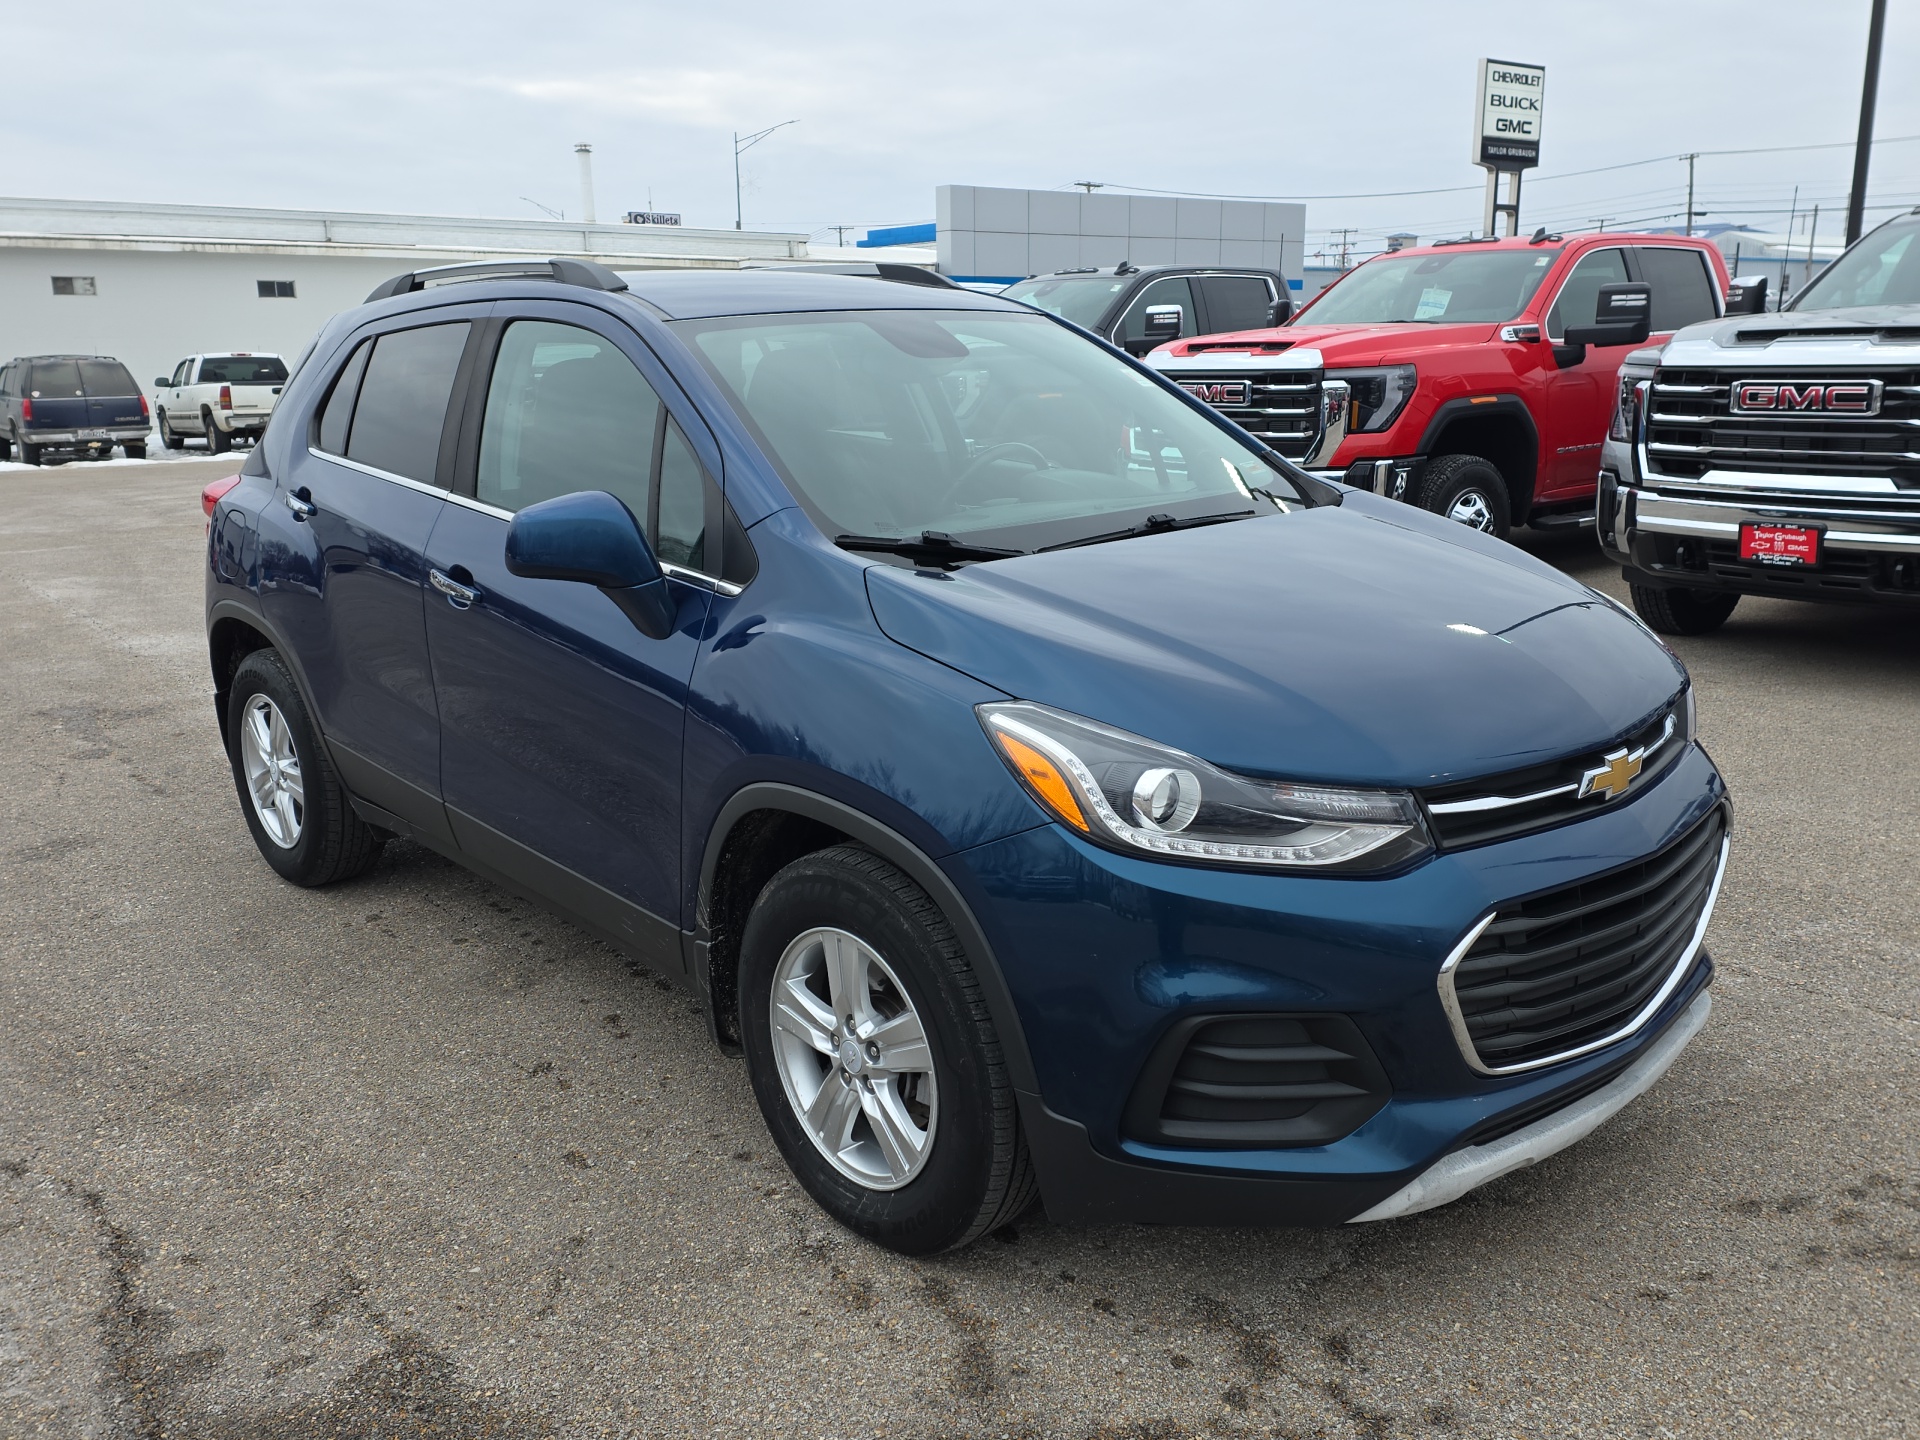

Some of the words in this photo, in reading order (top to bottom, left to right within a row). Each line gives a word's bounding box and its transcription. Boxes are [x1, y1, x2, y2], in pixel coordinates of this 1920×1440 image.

[1492, 70, 1542, 87] CHEVROLET
[1490, 94, 1540, 111] BUICK
[1496, 118, 1533, 134] GMC
[1487, 146, 1507, 156] TAYLOR
[1507, 147, 1537, 158] GRUBAUGH
[645, 213, 679, 226] Skillets
[1740, 386, 1869, 410] GMC
[1753, 530, 1774, 540] Taylor
[1774, 532, 1807, 542] Grubaugh
[1787, 544, 1809, 552] GMC
